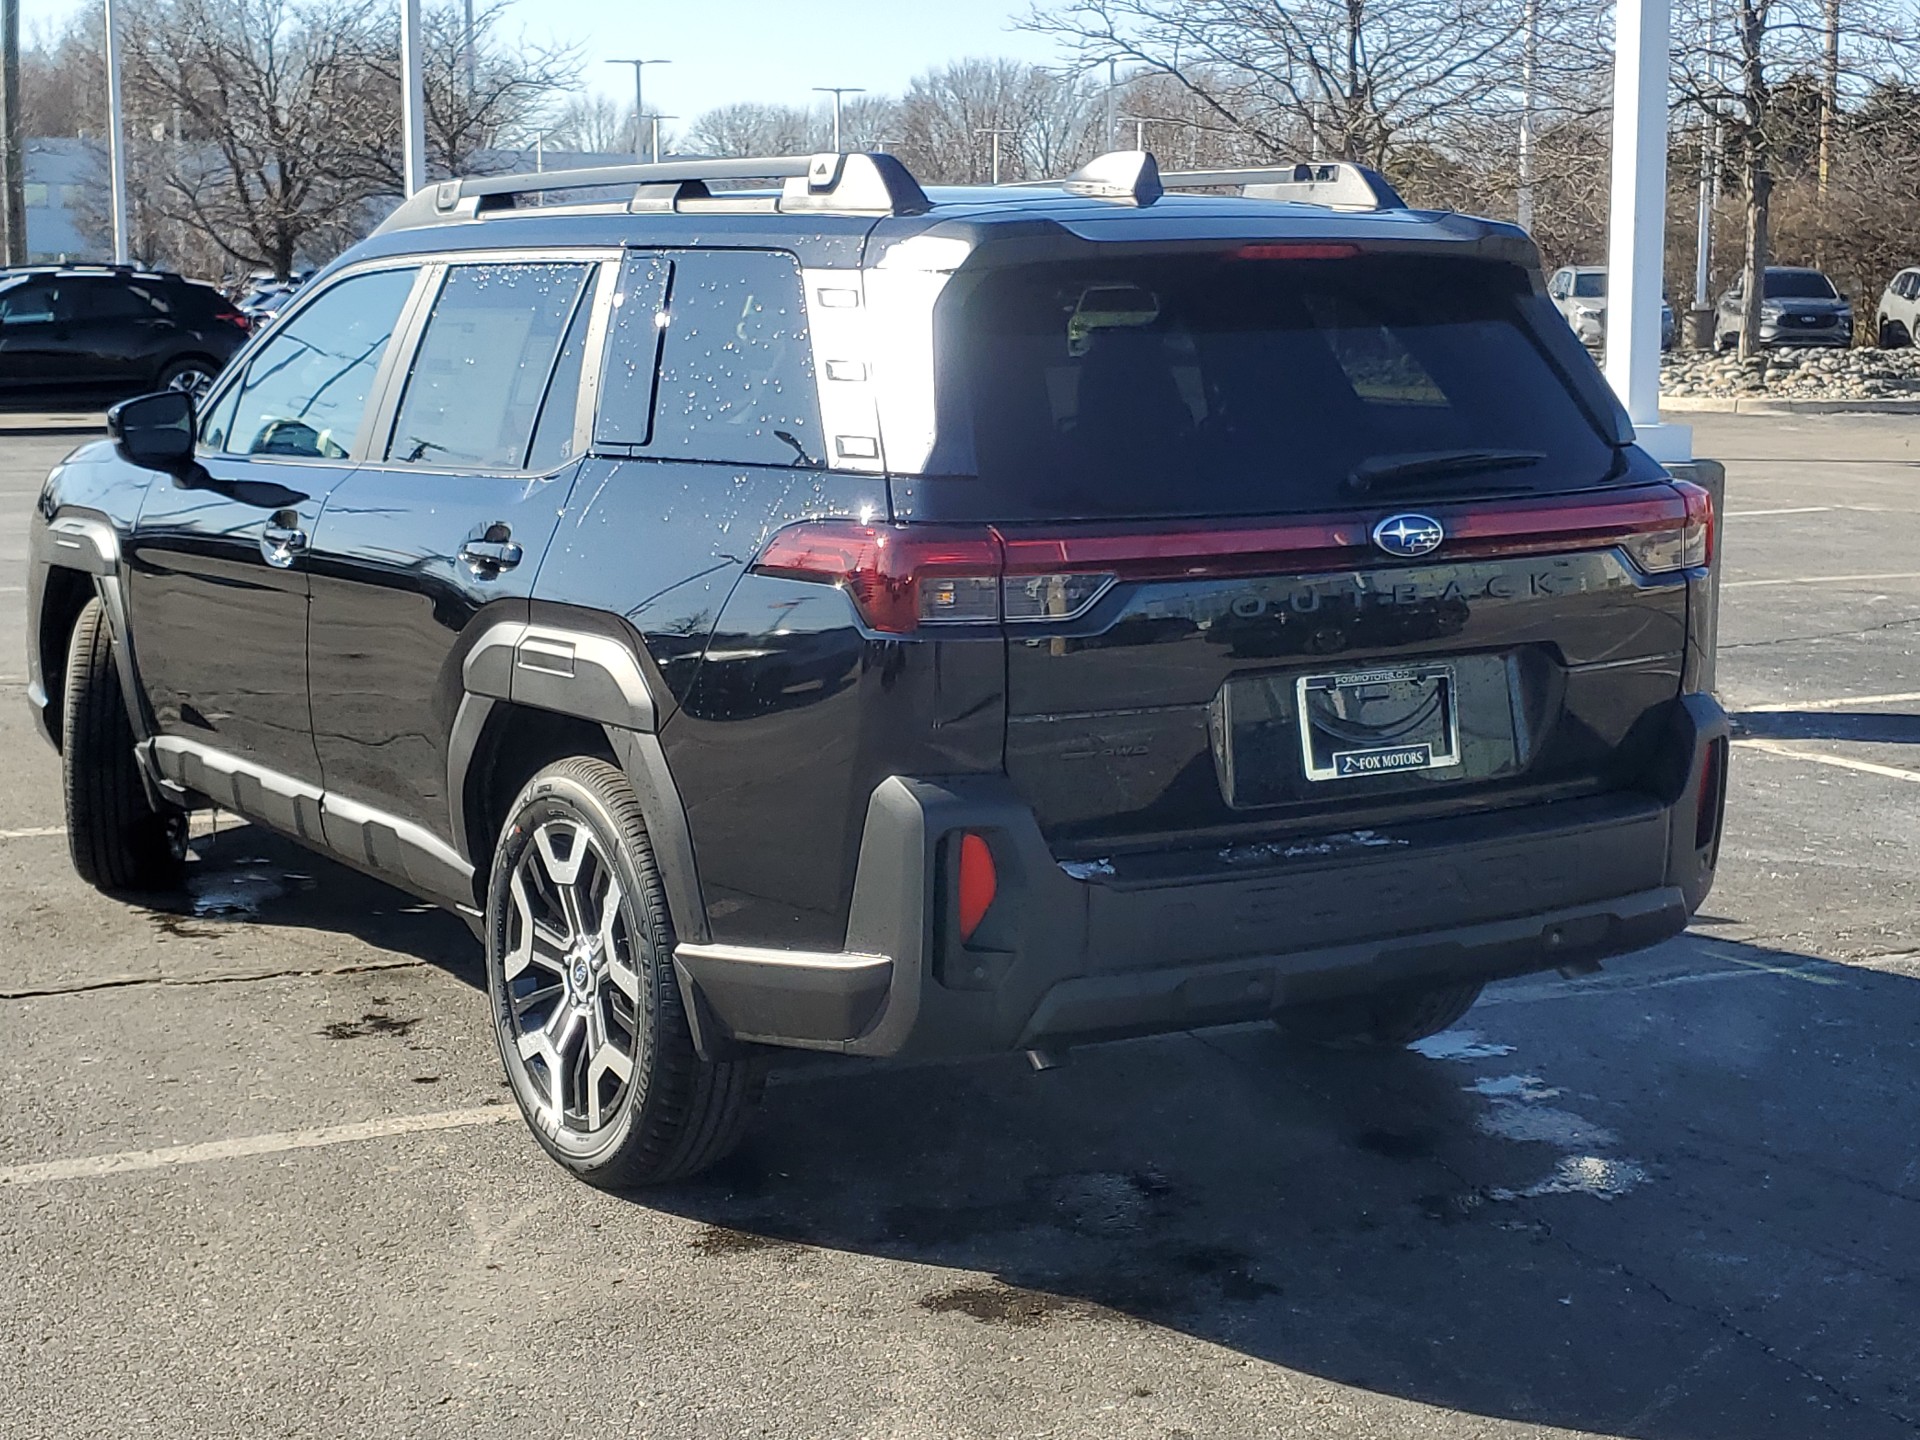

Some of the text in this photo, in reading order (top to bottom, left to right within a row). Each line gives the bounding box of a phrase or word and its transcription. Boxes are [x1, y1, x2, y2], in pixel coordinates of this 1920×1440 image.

[1233, 573, 1552, 617] OUTBACK
[1360, 752, 1423, 770] FOX MOTORS
